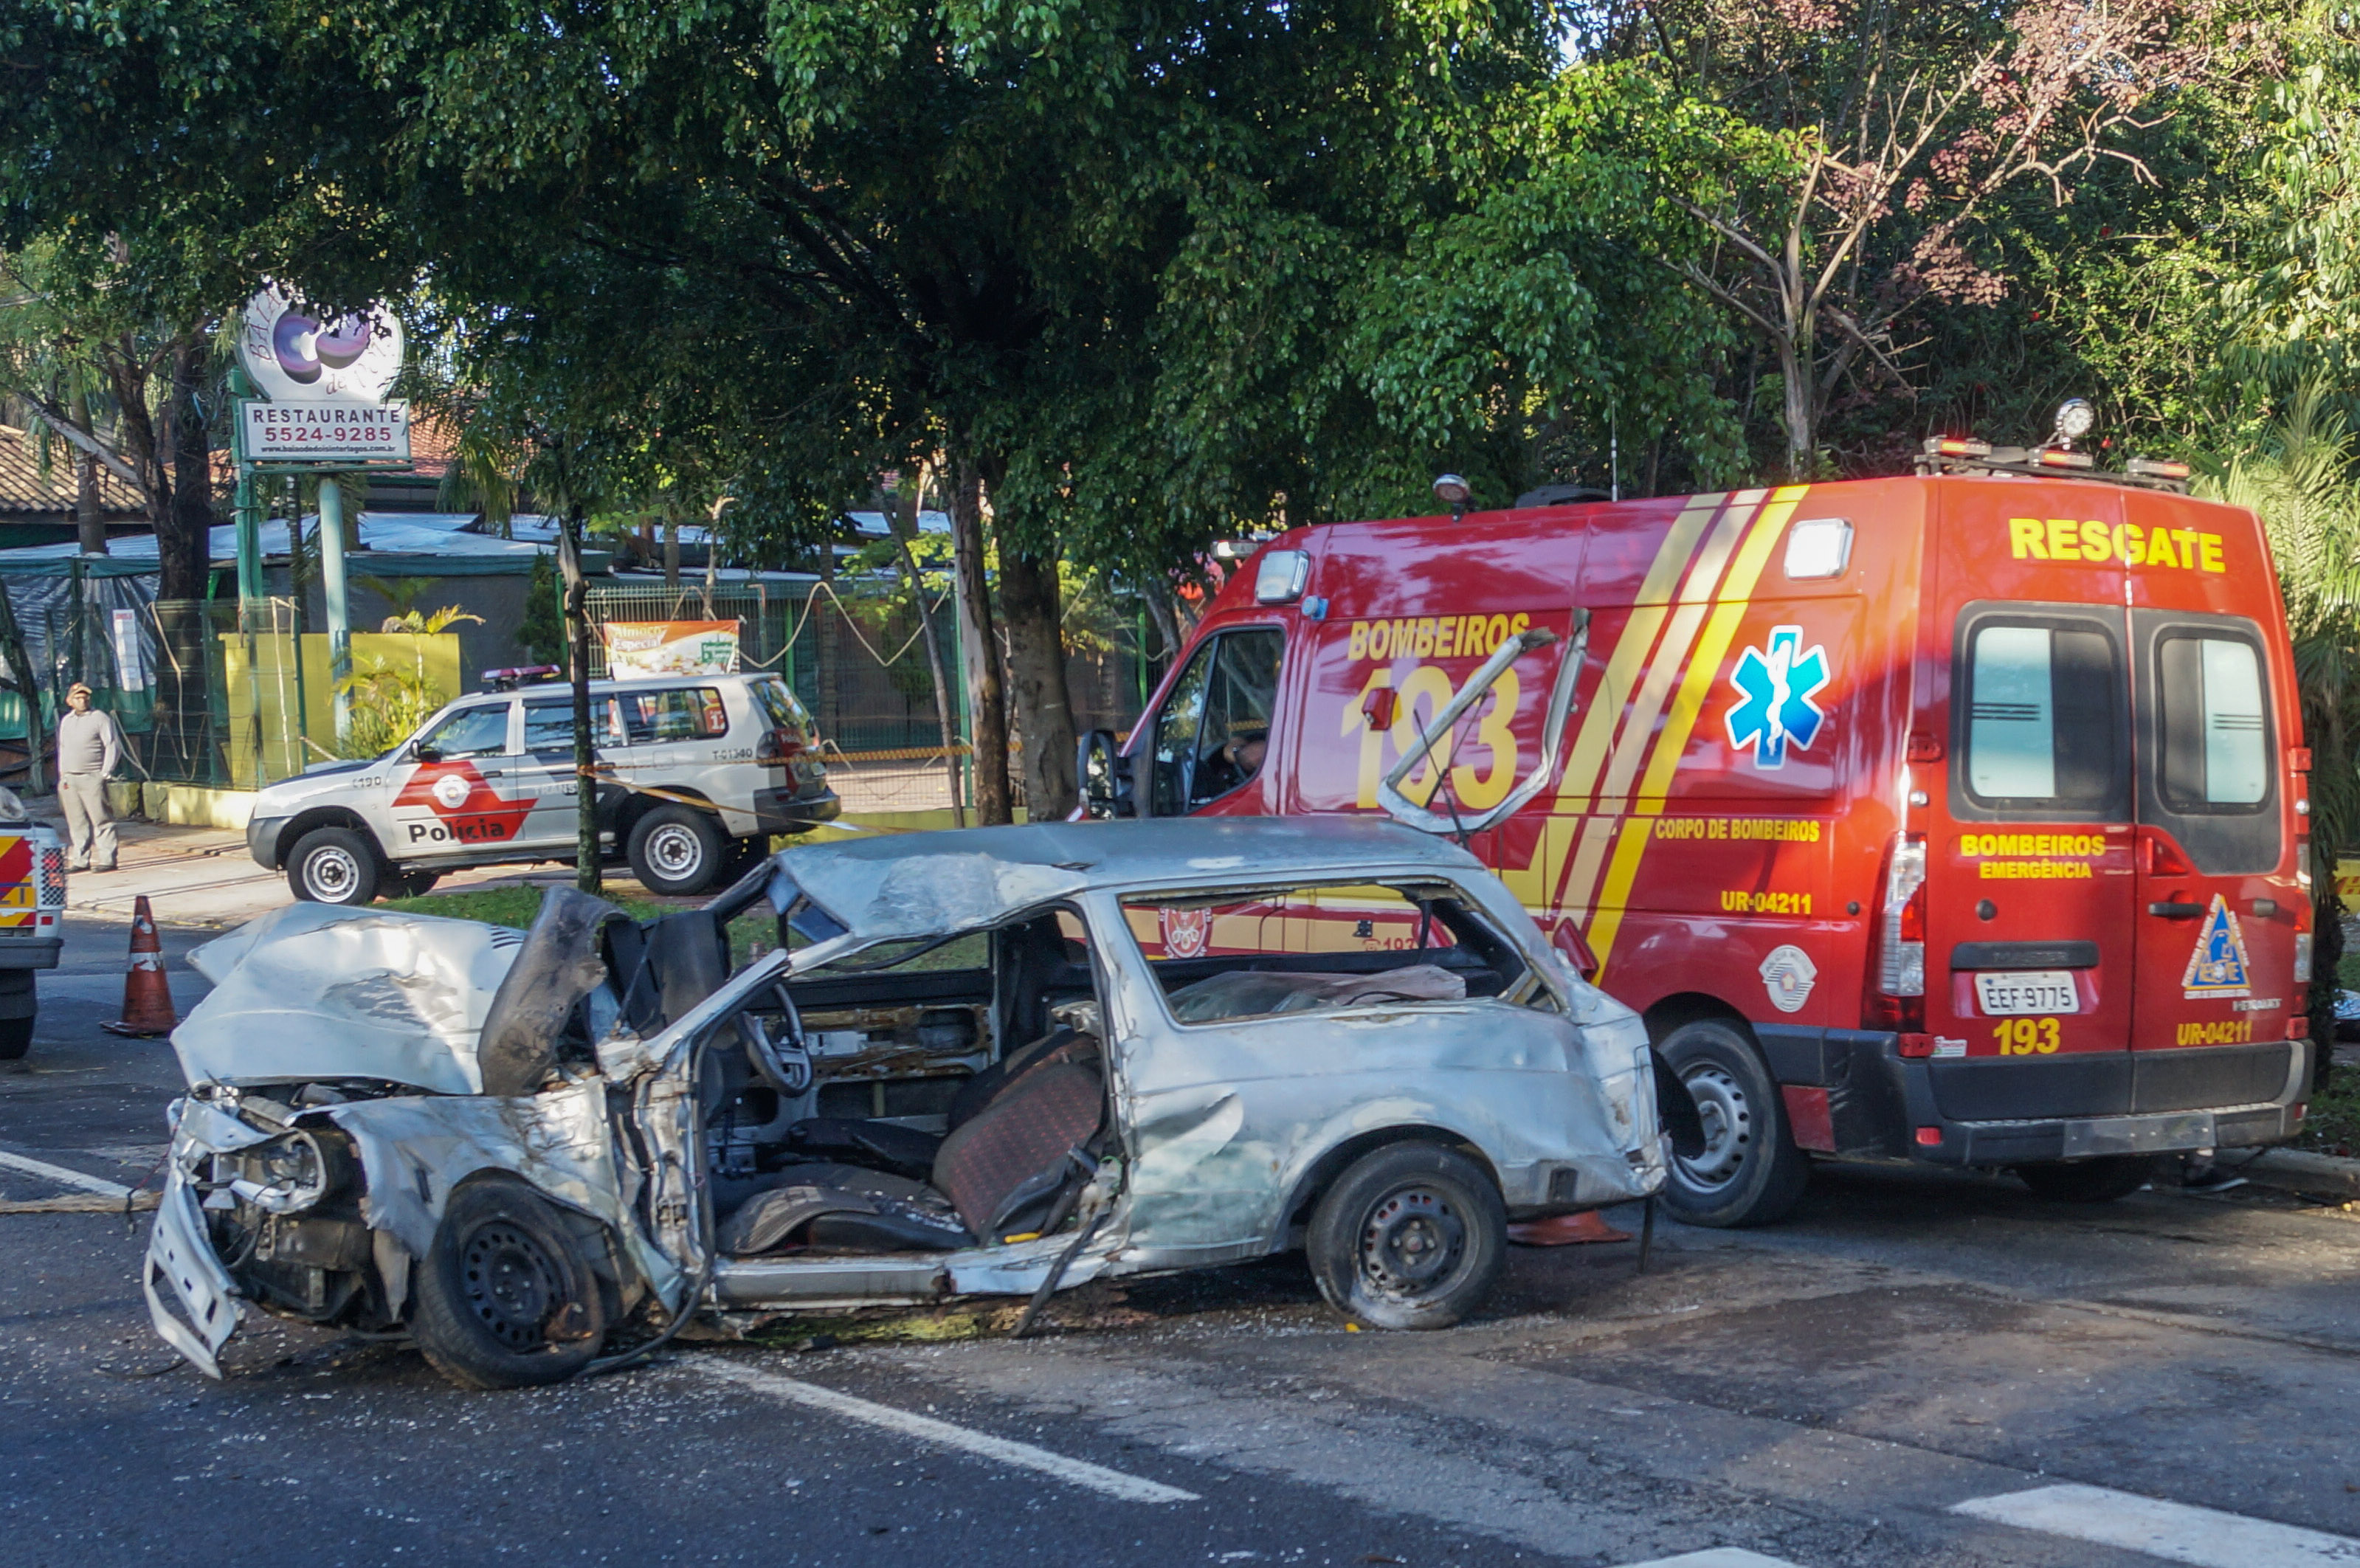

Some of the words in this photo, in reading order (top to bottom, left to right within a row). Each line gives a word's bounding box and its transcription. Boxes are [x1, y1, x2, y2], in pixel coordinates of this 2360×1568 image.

[253, 409, 400, 423] RESTAURANTE
[264, 426, 392, 442] 5524-9285
[2008, 517, 2226, 574] RESGATE
[1340, 663, 1520, 809] 193
[408, 818, 506, 843] Polícia
[1655, 818, 1705, 839] CORPO
[1708, 818, 1728, 839] DE
[1731, 818, 1821, 843] BOMBEIROS
[1960, 834, 2106, 857] BOMBEIROS
[1979, 858, 2093, 879] EMERGÊNCIA
[1720, 891, 1812, 914] UR-04211
[1992, 1017, 2061, 1056] 193
[2178, 1020, 2253, 1046] UR-04211
